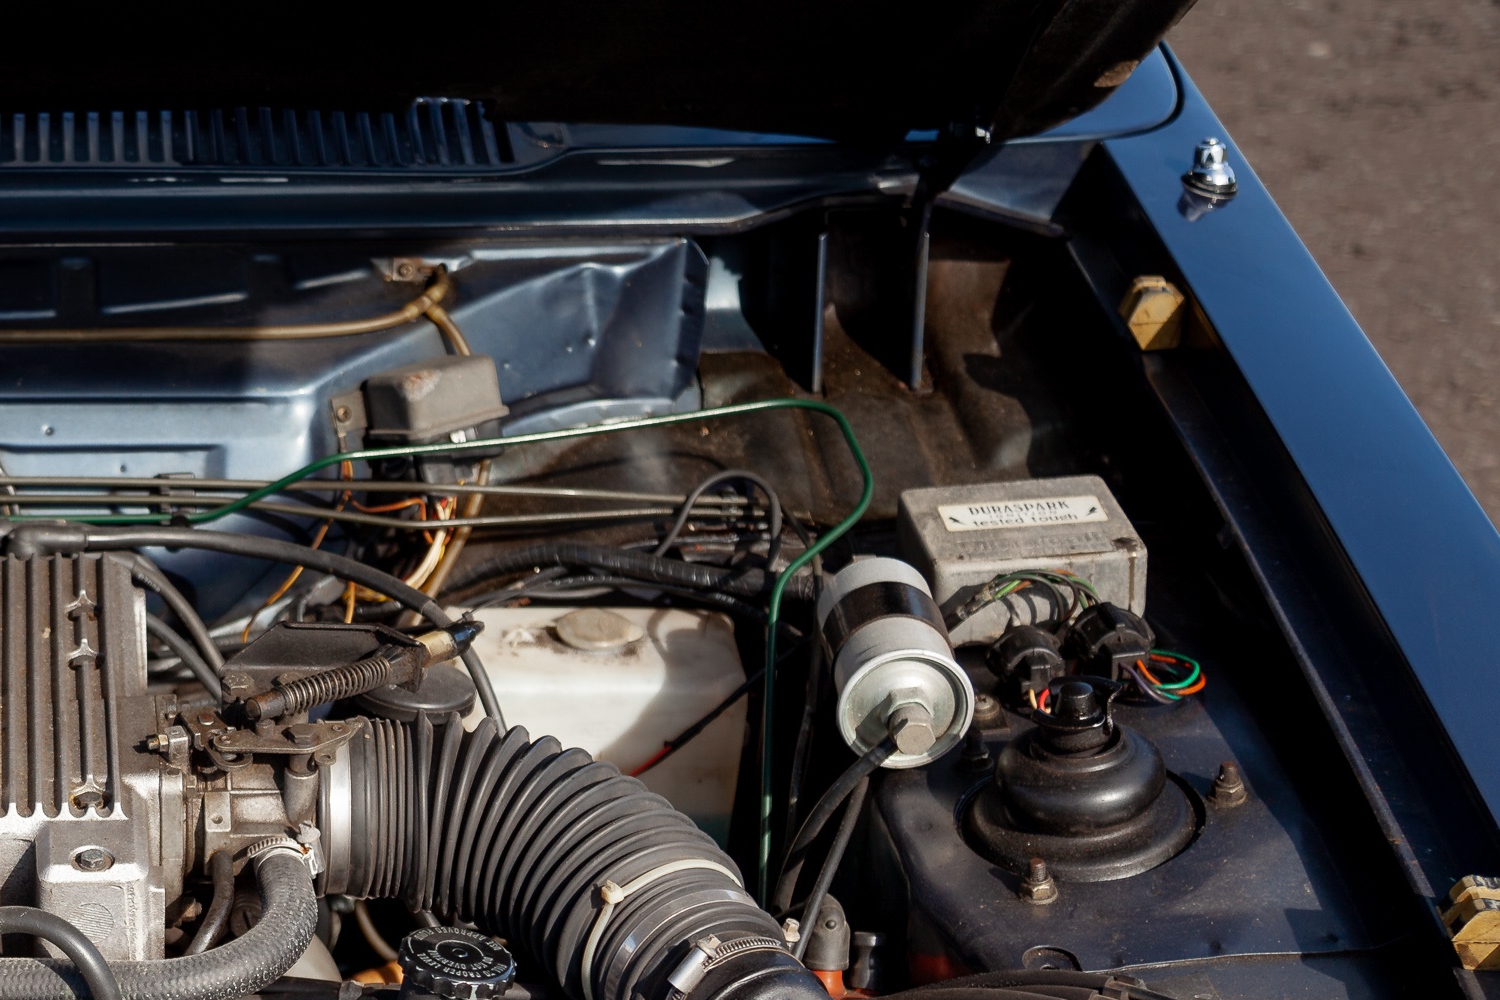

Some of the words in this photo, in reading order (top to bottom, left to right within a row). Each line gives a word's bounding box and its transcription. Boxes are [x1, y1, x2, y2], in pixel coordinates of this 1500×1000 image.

[969, 500, 1069, 516] DURASPARK
[973, 517, 1024, 527] tested
[1031, 512, 1078, 523] tough
[435, 927, 487, 941] APPROVED
[487, 941, 502, 951] USE
[417, 953, 441, 969] LEVEL
[442, 966, 482, 978] PROPER
